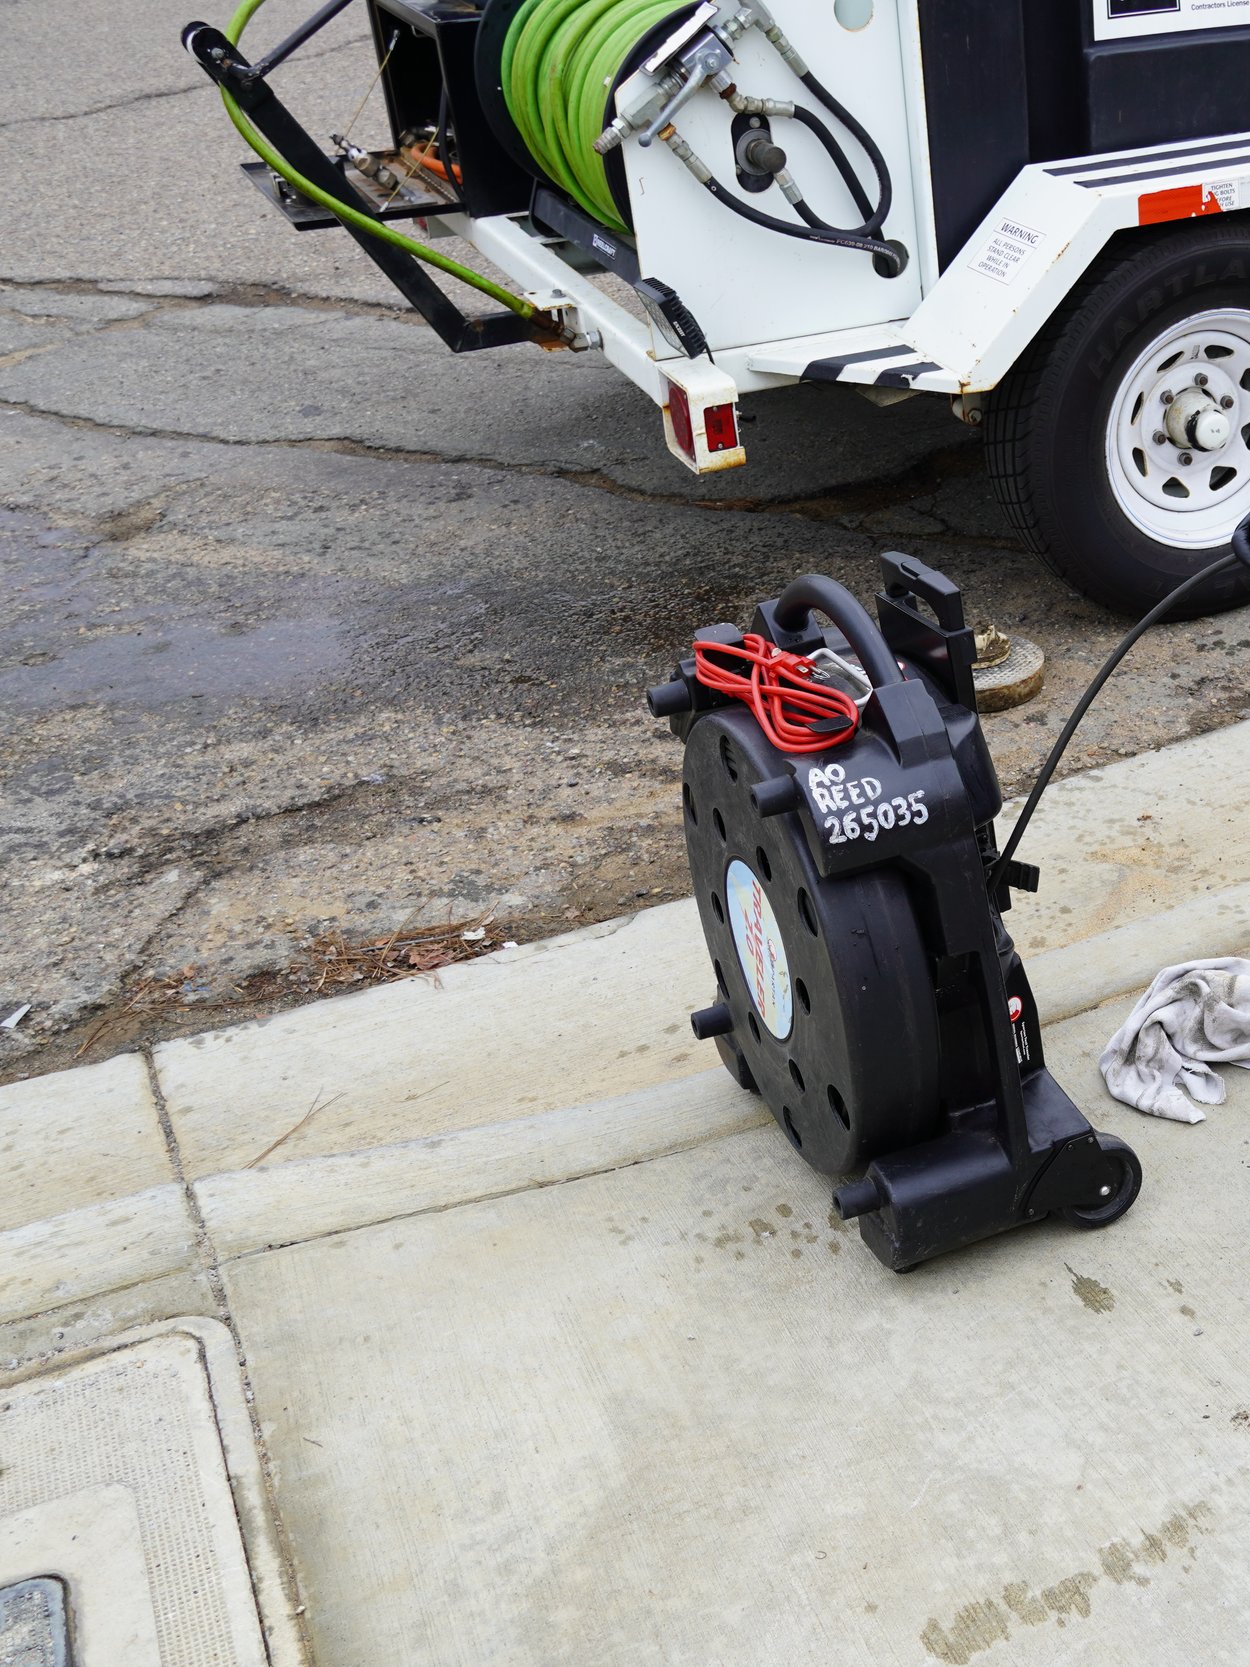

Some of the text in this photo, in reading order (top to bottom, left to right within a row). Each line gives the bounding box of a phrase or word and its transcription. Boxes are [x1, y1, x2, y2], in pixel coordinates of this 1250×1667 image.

[1191, 2, 1226, 11] Contractors
[1226, 0, 1250, 8] License
[1001, 222, 1039, 244] WARNING
[987, 245, 1021, 263] STAND CLEAR
[993, 238, 1027, 256] ALL PERSONS
[978, 261, 1007, 277] OPERATION
[986, 254, 1003, 266] WHILE
[808, 763, 846, 790] AO
[812, 777, 882, 814] REED
[824, 789, 929, 844] 265035
[752, 879, 766, 1019] TRAVELER
